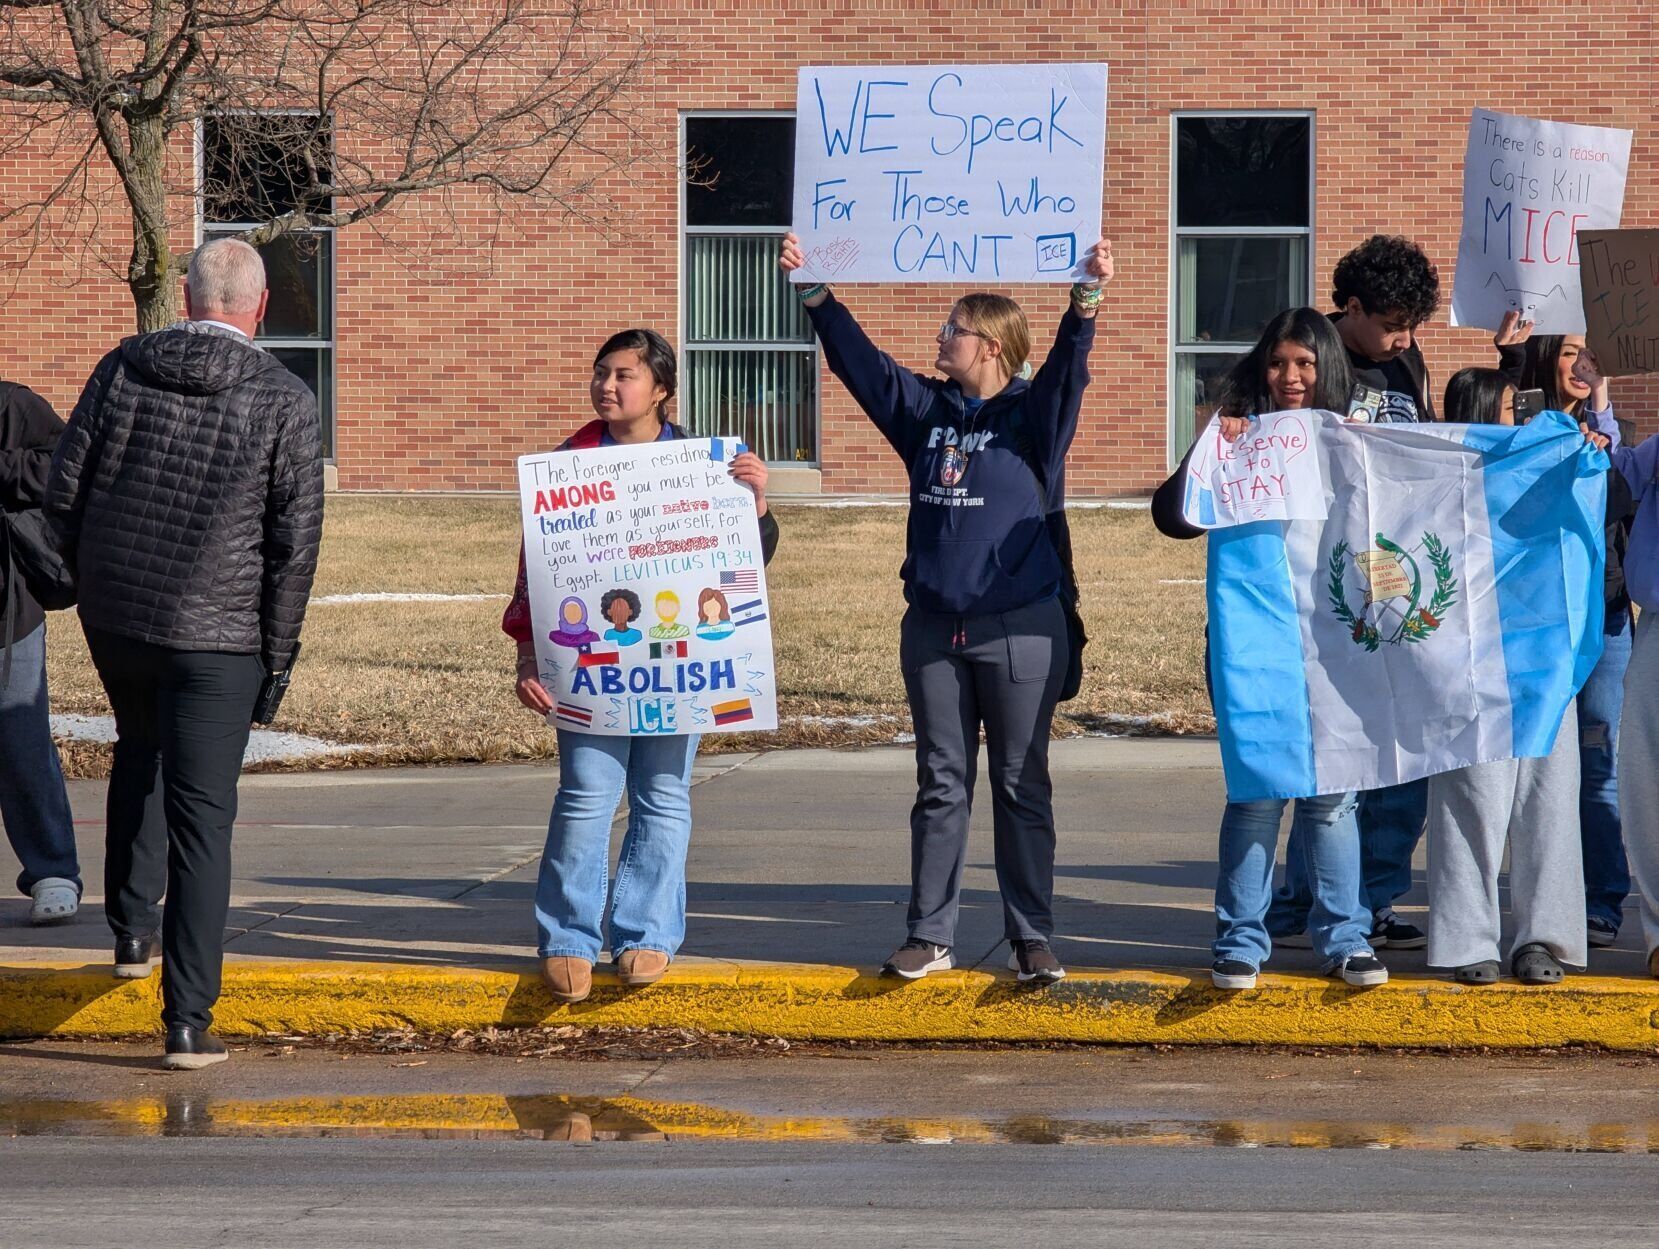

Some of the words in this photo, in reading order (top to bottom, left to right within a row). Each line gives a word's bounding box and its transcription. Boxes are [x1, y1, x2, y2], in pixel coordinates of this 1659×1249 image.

[815, 78, 908, 157] WE
[929, 73, 1083, 174] Speak
[1482, 117, 1524, 152] There
[1553, 146, 1562, 157] a
[1569, 147, 1610, 163] reason
[812, 179, 856, 229] For
[883, 171, 969, 221] Those
[998, 177, 1076, 217] Who
[1489, 159, 1539, 200] Cats
[1552, 168, 1591, 204] Kill
[893, 224, 1013, 277] CANT
[1041, 243, 1067, 261] ICE
[1484, 196, 1589, 265] MICE
[1580, 239, 1641, 287] The
[1592, 289, 1649, 341] ICE
[525, 461, 568, 485] The
[573, 455, 637, 480] foreigner
[651, 443, 714, 468] residing
[1245, 458, 1270, 471] to
[534, 481, 616, 514] AMONG
[628, 481, 651, 501] you
[660, 473, 698, 491] must
[705, 472, 725, 487] be
[962, 497, 984, 506] YORK
[537, 508, 598, 535] treated
[606, 510, 622, 524] as
[630, 504, 658, 527] your
[543, 537, 571, 555] Love
[583, 533, 618, 548] them
[626, 530, 642, 543] as
[649, 513, 714, 541] yourself,
[719, 512, 743, 527] for
[548, 554, 577, 572] you
[586, 547, 626, 563] were
[727, 532, 741, 545] in
[554, 569, 603, 593] Egypt.
[614, 555, 704, 583] LEVITICUS
[712, 550, 753, 568] 19:34
[571, 659, 736, 695] ABOLISH
[627, 696, 678, 733] ICE
